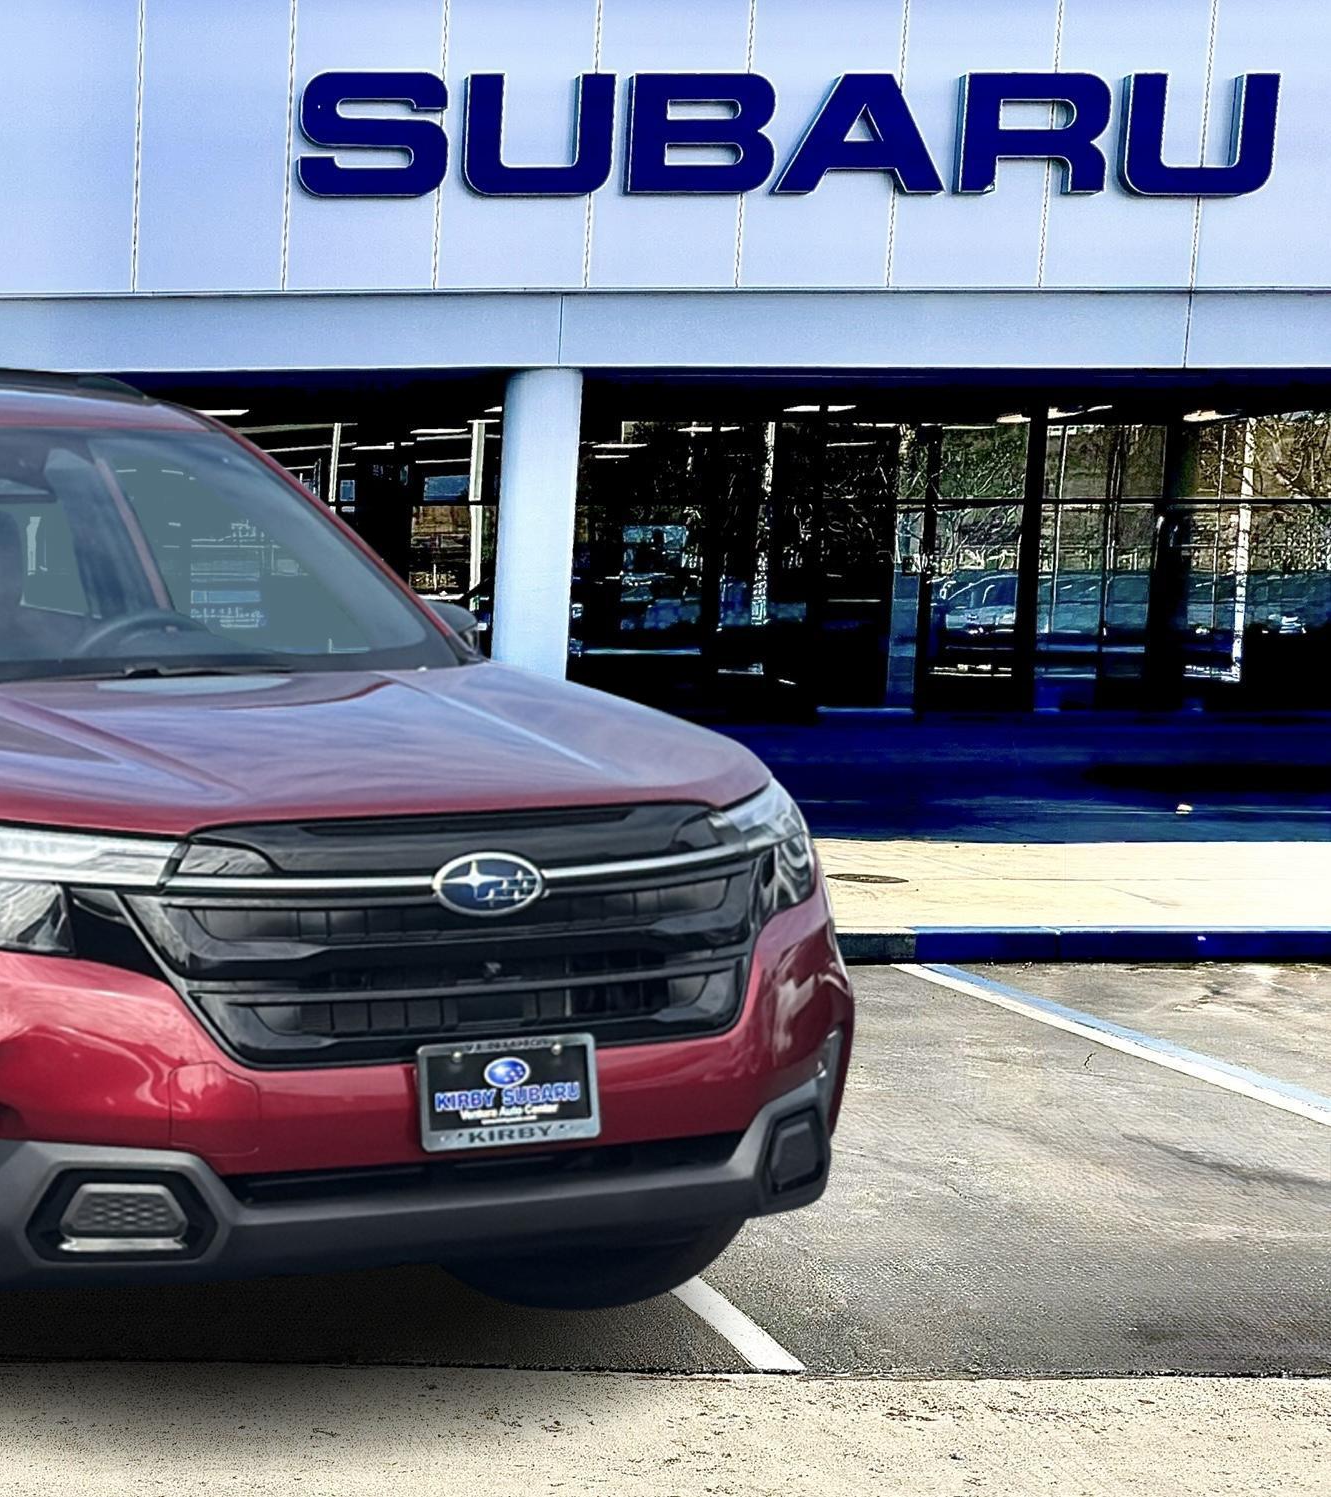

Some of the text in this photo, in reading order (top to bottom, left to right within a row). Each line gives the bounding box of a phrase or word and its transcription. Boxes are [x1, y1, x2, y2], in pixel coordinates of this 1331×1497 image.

[296, 71, 1282, 196] SUBARU
[434, 1082, 580, 1112] KIRBY SUBARU
[499, 1105, 523, 1117] Auto
[469, 1125, 553, 1144] KIRBY
